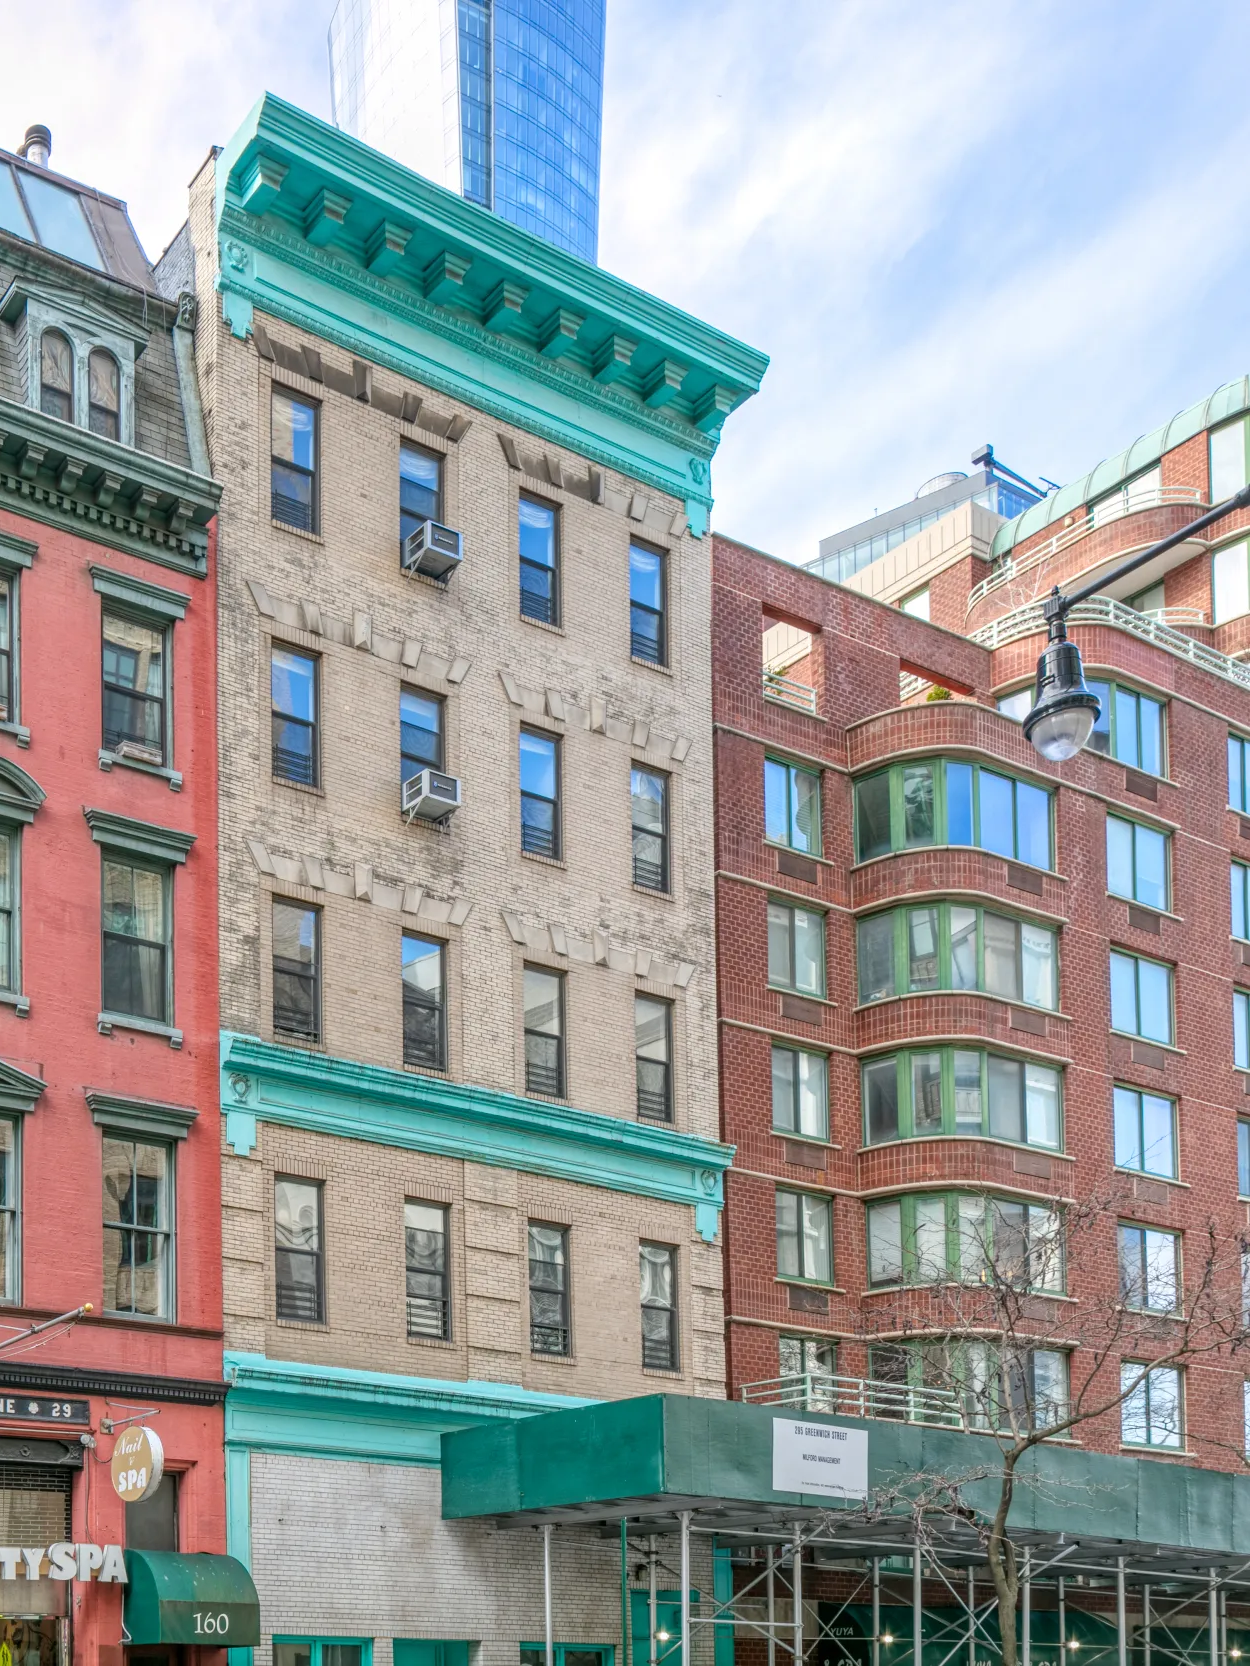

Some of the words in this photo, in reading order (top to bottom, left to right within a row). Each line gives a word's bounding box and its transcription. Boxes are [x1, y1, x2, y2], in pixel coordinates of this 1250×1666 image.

[51, 1402, 72, 1418] 29
[805, 1427, 830, 1438] GREENWICH
[831, 1431, 847, 1440] STREET
[114, 1433, 143, 1456] Nail
[818, 1456, 840, 1464] MANAGEMENT
[118, 1467, 147, 1493] SPA
[47, 1541, 129, 1583] SPA
[193, 1612, 229, 1634] 160
[830, 1627, 854, 1636] YUYA
